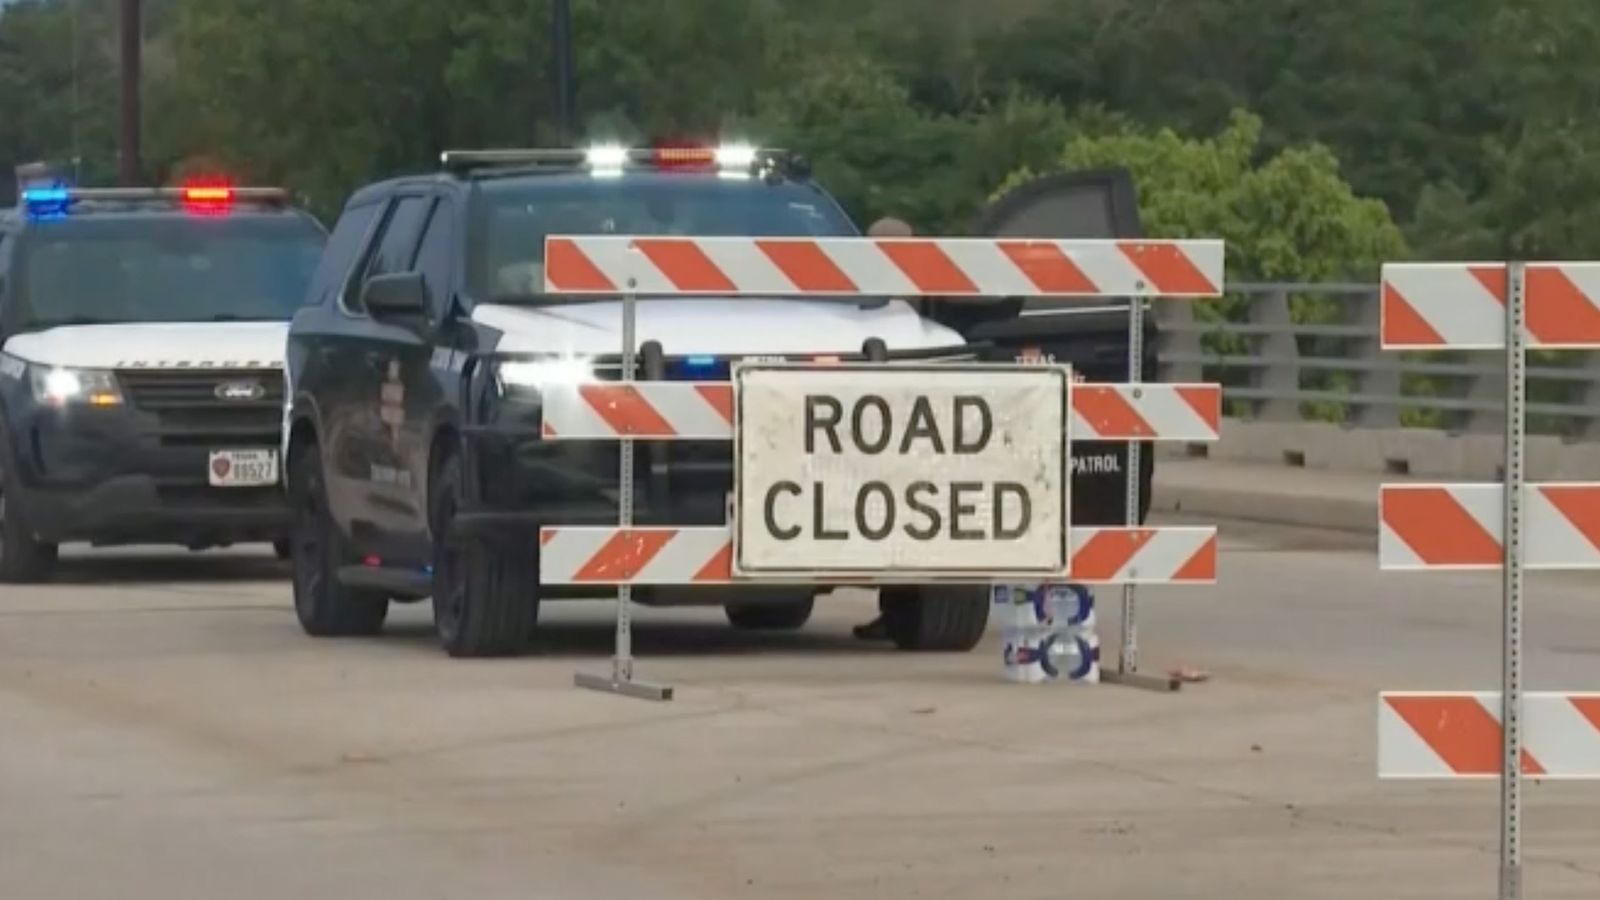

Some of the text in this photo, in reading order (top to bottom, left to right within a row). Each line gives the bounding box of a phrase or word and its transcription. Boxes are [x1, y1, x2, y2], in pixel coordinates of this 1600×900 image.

[804, 395, 993, 454] ROAD
[1071, 454, 1121, 474] PATROL
[763, 480, 1033, 541] CLOSED
